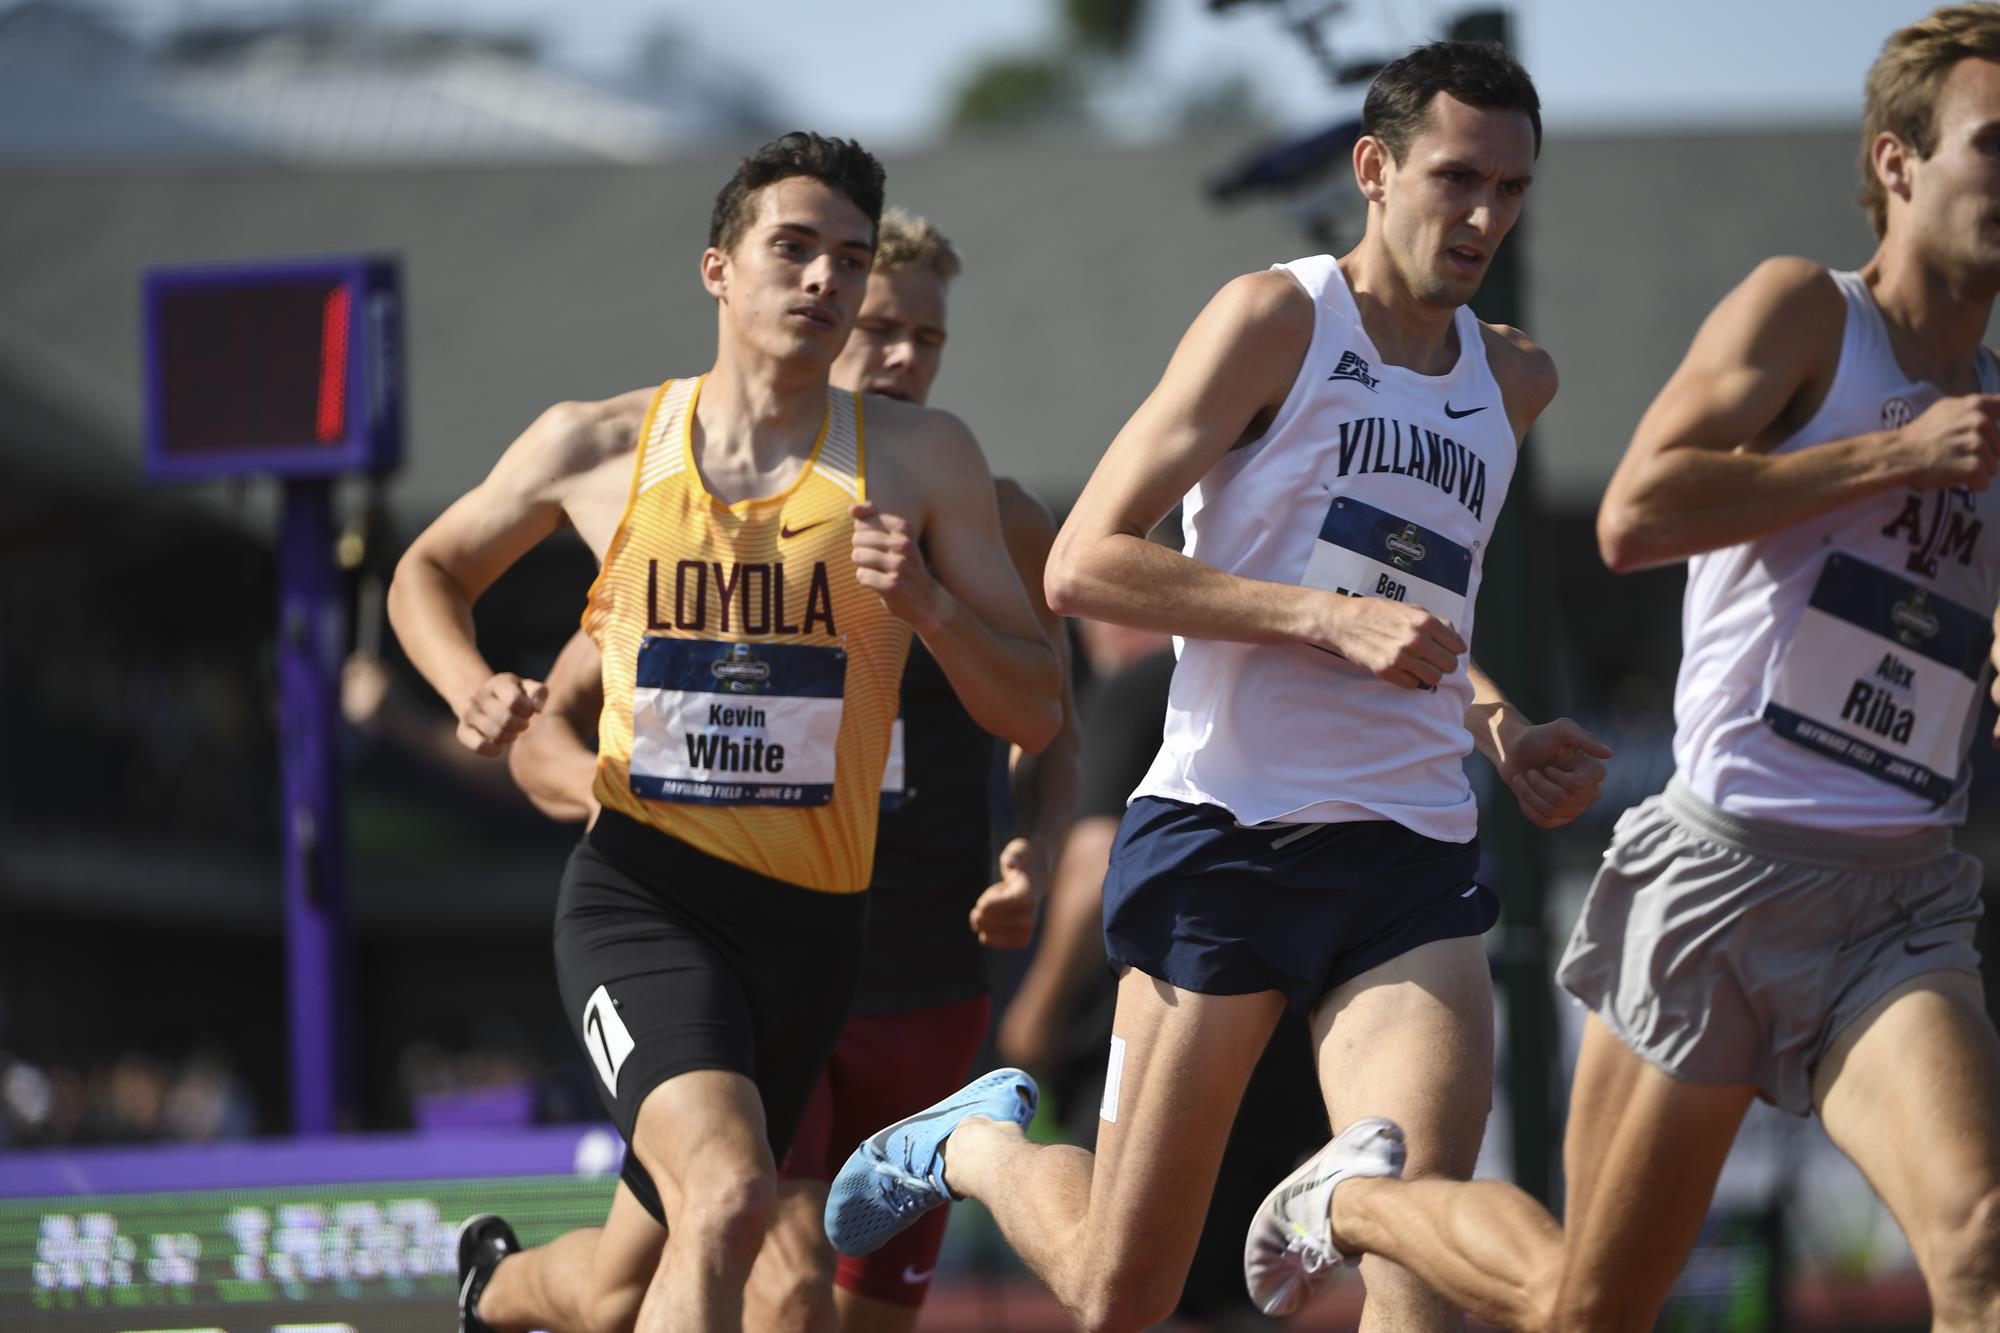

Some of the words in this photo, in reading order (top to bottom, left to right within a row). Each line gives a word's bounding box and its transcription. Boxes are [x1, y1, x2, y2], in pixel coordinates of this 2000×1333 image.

[1333, 362, 1380, 388] EAST
[1340, 350, 1369, 373] BIG
[1336, 417, 1486, 522] VILLANOVA
[648, 559, 836, 635] LOYOLA
[1376, 572, 1407, 602] Ben
[1876, 652, 1915, 691] Alex
[709, 704, 766, 728] Kevin
[1841, 679, 1915, 746] Riba
[686, 733, 785, 773] White
[1848, 743, 1877, 766] FIELD
[662, 781, 714, 798] HAYWARD
[713, 785, 742, 799] FIELD
[755, 787, 783, 799] JUNE
[587, 1003, 615, 1076] 7
